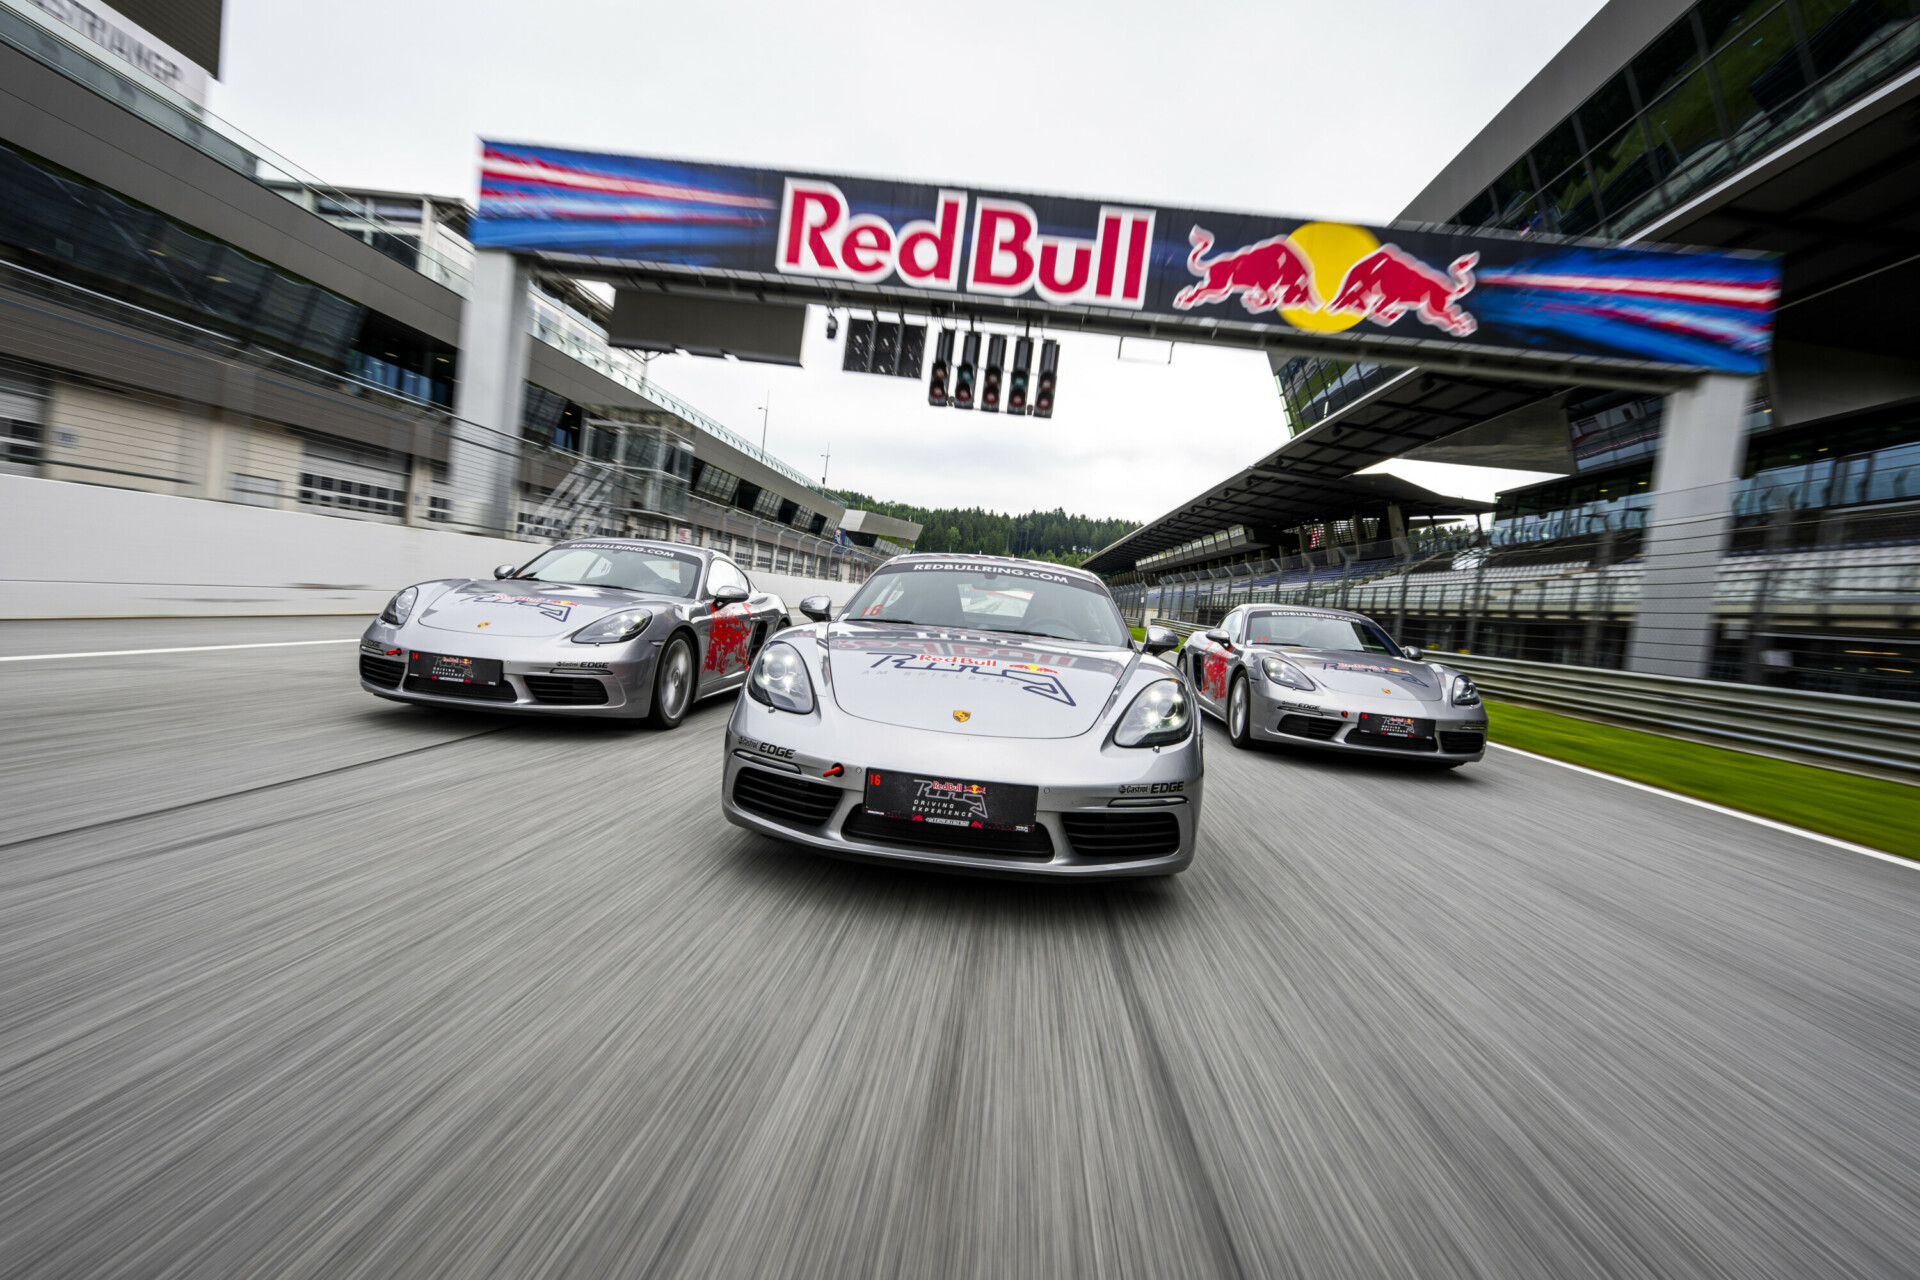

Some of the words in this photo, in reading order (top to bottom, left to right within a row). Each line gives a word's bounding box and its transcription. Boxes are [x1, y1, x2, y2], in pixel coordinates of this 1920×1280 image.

[780, 180, 965, 289] Red
[969, 200, 1154, 308] Bull
[569, 543, 675, 558] REDBULLRING.COM
[913, 563, 1068, 584] REDBULLRING.COM
[860, 604, 883, 618] 16
[1271, 611, 1362, 624] REDBULLRING.COM
[579, 661, 609, 669] EDGE
[919, 655, 957, 664] Red
[960, 658, 997, 667] Bull
[759, 742, 797, 759] EDGE
[869, 773, 881, 786] 16
[933, 780, 947, 790] Red
[948, 783, 963, 792] Bull
[1126, 785, 1149, 794] Castrol
[1150, 780, 1184, 794] EDGE
[913, 799, 955, 809] DRIVING
[912, 805, 973, 817] EXPERIENCE
